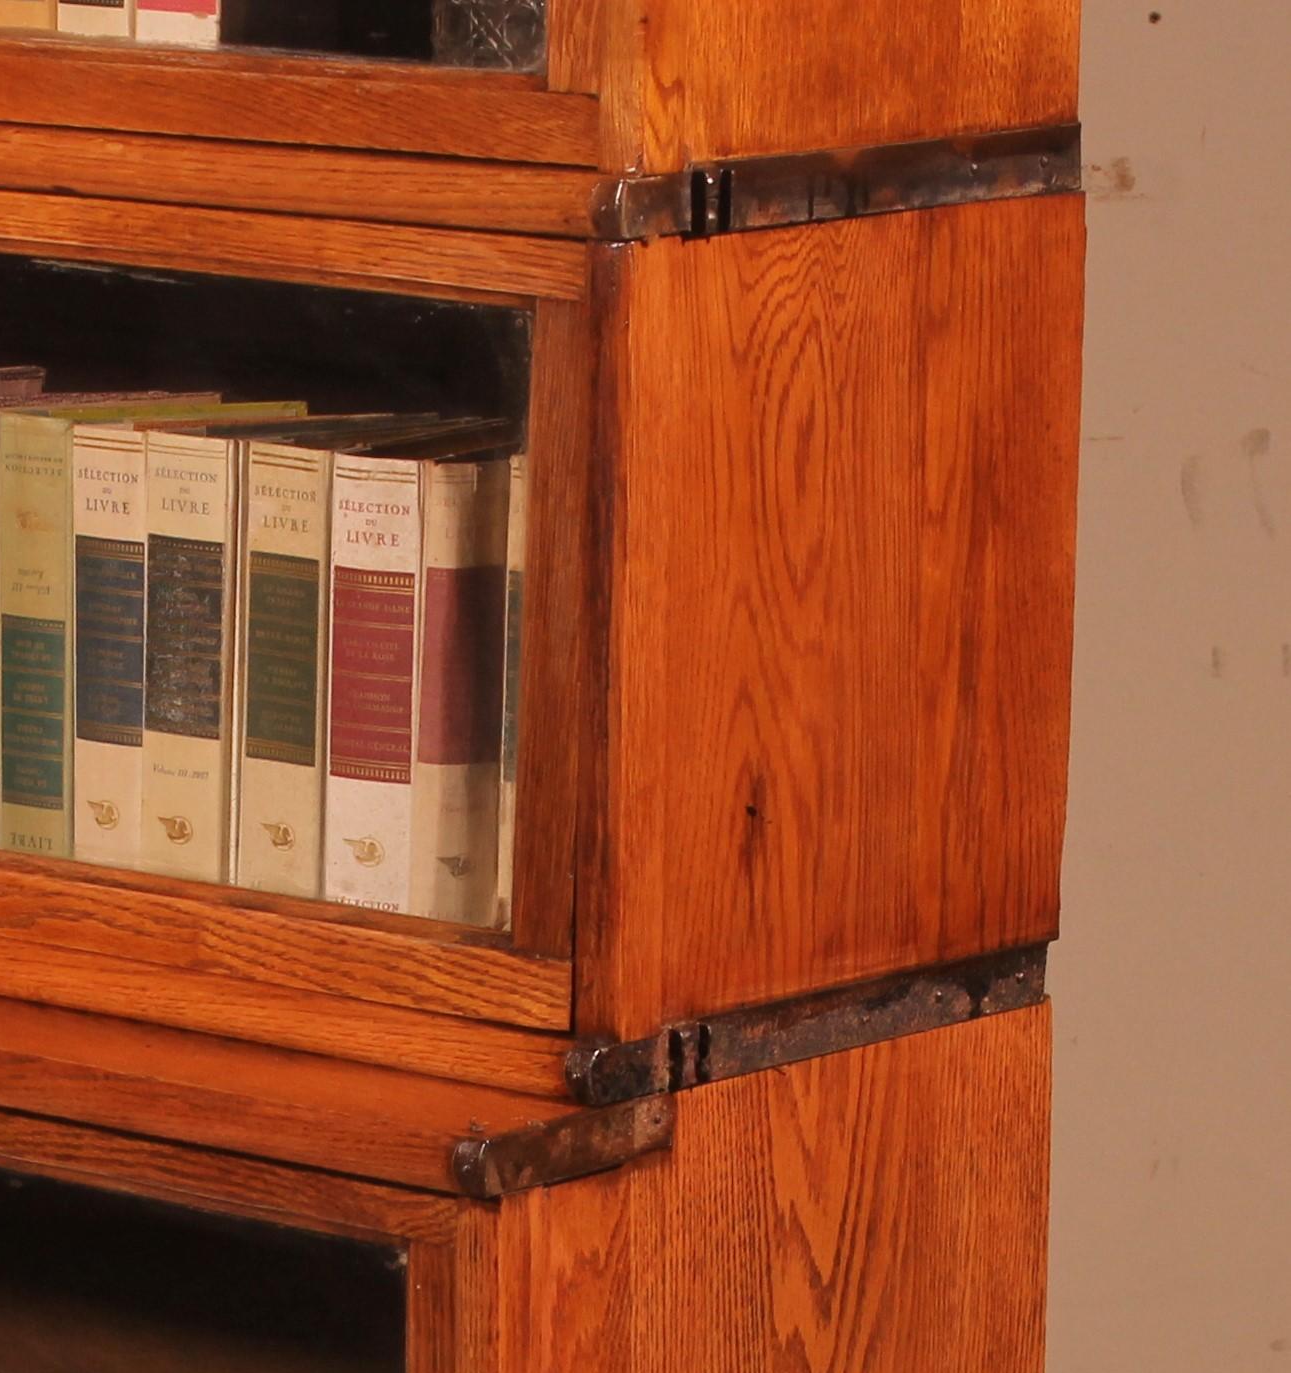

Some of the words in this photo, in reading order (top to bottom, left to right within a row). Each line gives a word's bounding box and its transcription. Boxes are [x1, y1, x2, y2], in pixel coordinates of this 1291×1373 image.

[78, 466, 138, 484] SÉLECTION
[155, 466, 217, 483] SÉLECTION
[254, 484, 318, 502] SÉLECTION
[86, 497, 130, 515] LIVRE
[162, 497, 210, 516] LIVRE
[339, 499, 410, 516] SÉLECTION
[263, 515, 309, 533] LIVRE
[366, 519, 377, 527] DU
[347, 530, 400, 547] LIVRE
[11, 832, 53, 850] LIVRE
